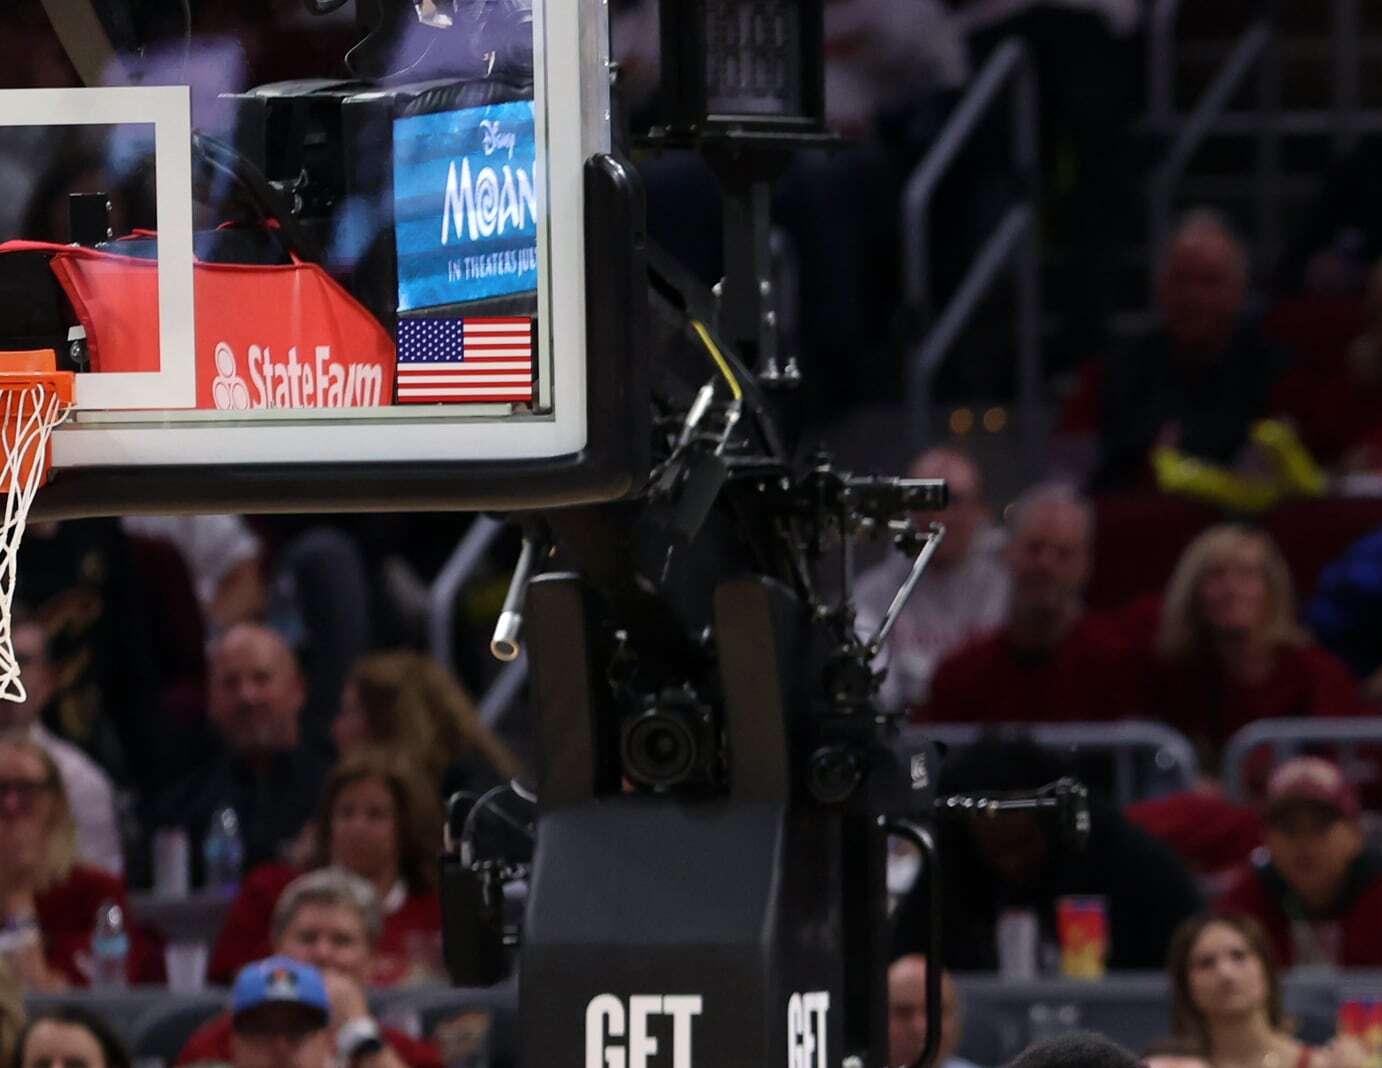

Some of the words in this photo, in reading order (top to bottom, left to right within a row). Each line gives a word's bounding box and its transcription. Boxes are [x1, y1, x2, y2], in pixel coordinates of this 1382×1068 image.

[448, 259, 461, 283] IN
[464, 250, 516, 280] THEATERS
[518, 247, 537, 277] JUL
